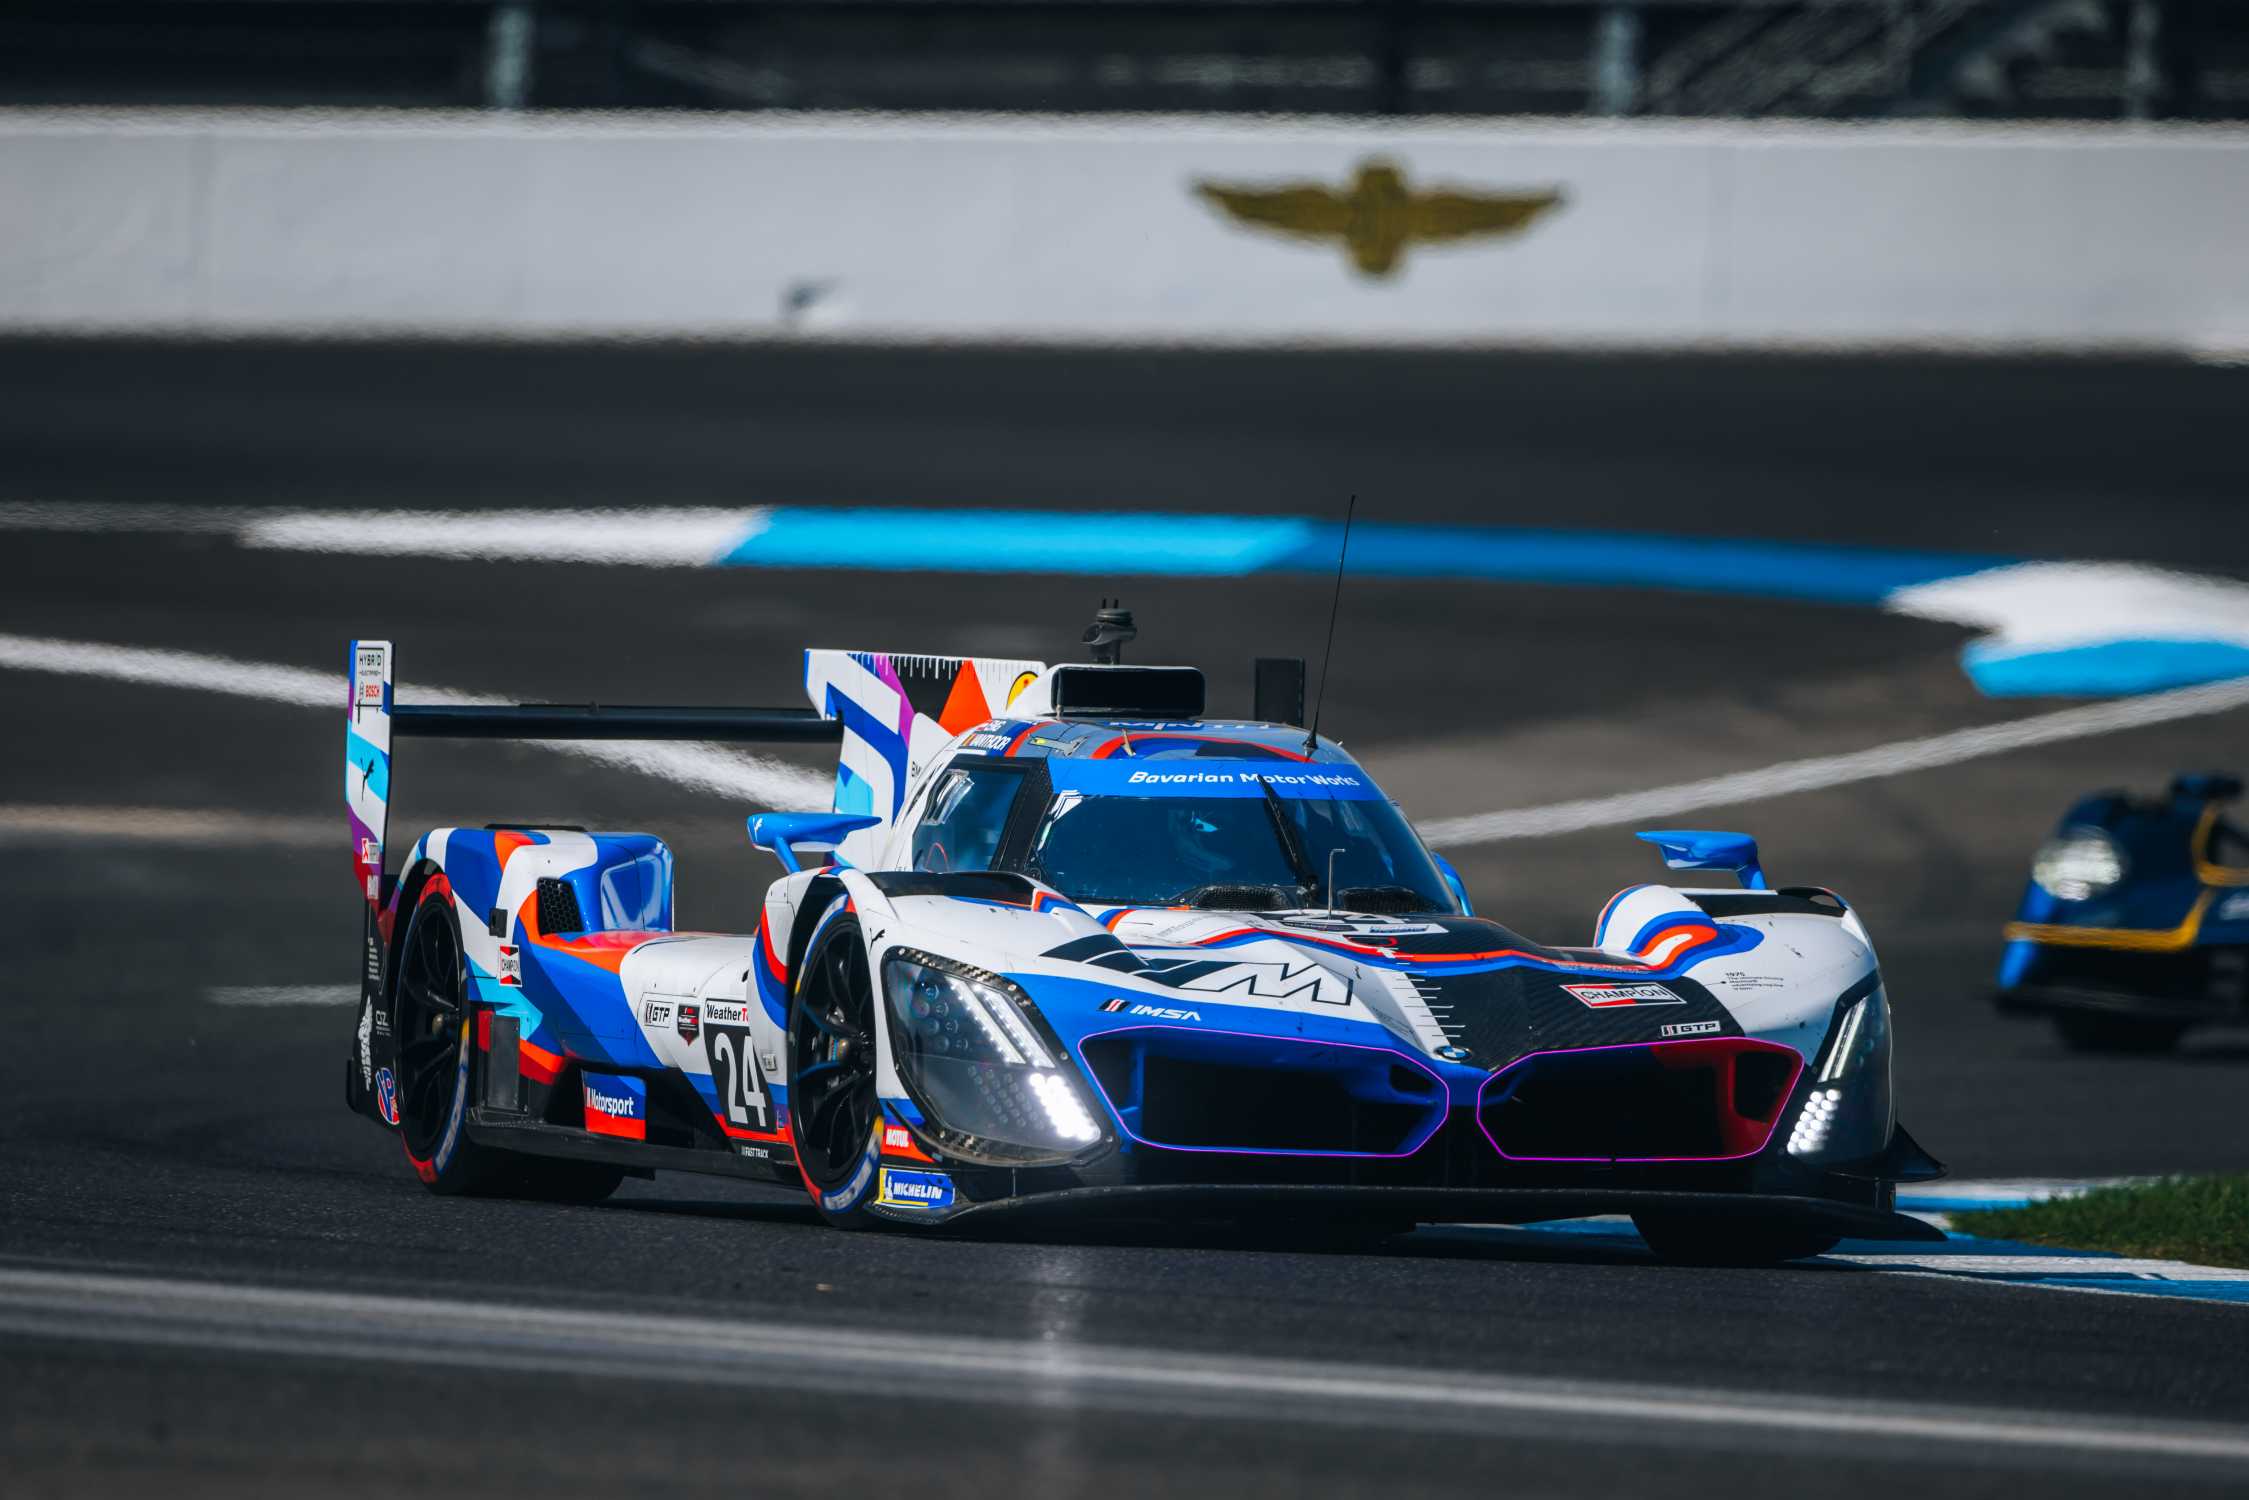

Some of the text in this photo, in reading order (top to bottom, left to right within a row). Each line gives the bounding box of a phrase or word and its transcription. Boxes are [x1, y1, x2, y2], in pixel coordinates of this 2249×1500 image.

[1128, 771, 1361, 787] Bavarian Motor Works
[1580, 986, 1667, 1000] CHAMPION
[652, 1006, 671, 1022] GTP
[706, 1004, 749, 1022] WeatherT
[1129, 1004, 1201, 1021] IMSA
[1680, 1023, 1717, 1033] GTP
[714, 1032, 767, 1128] 24
[590, 1087, 635, 1119] Motorsport
[885, 1128, 910, 1148] MOTUL
[892, 1181, 944, 1200] MICHELIN
